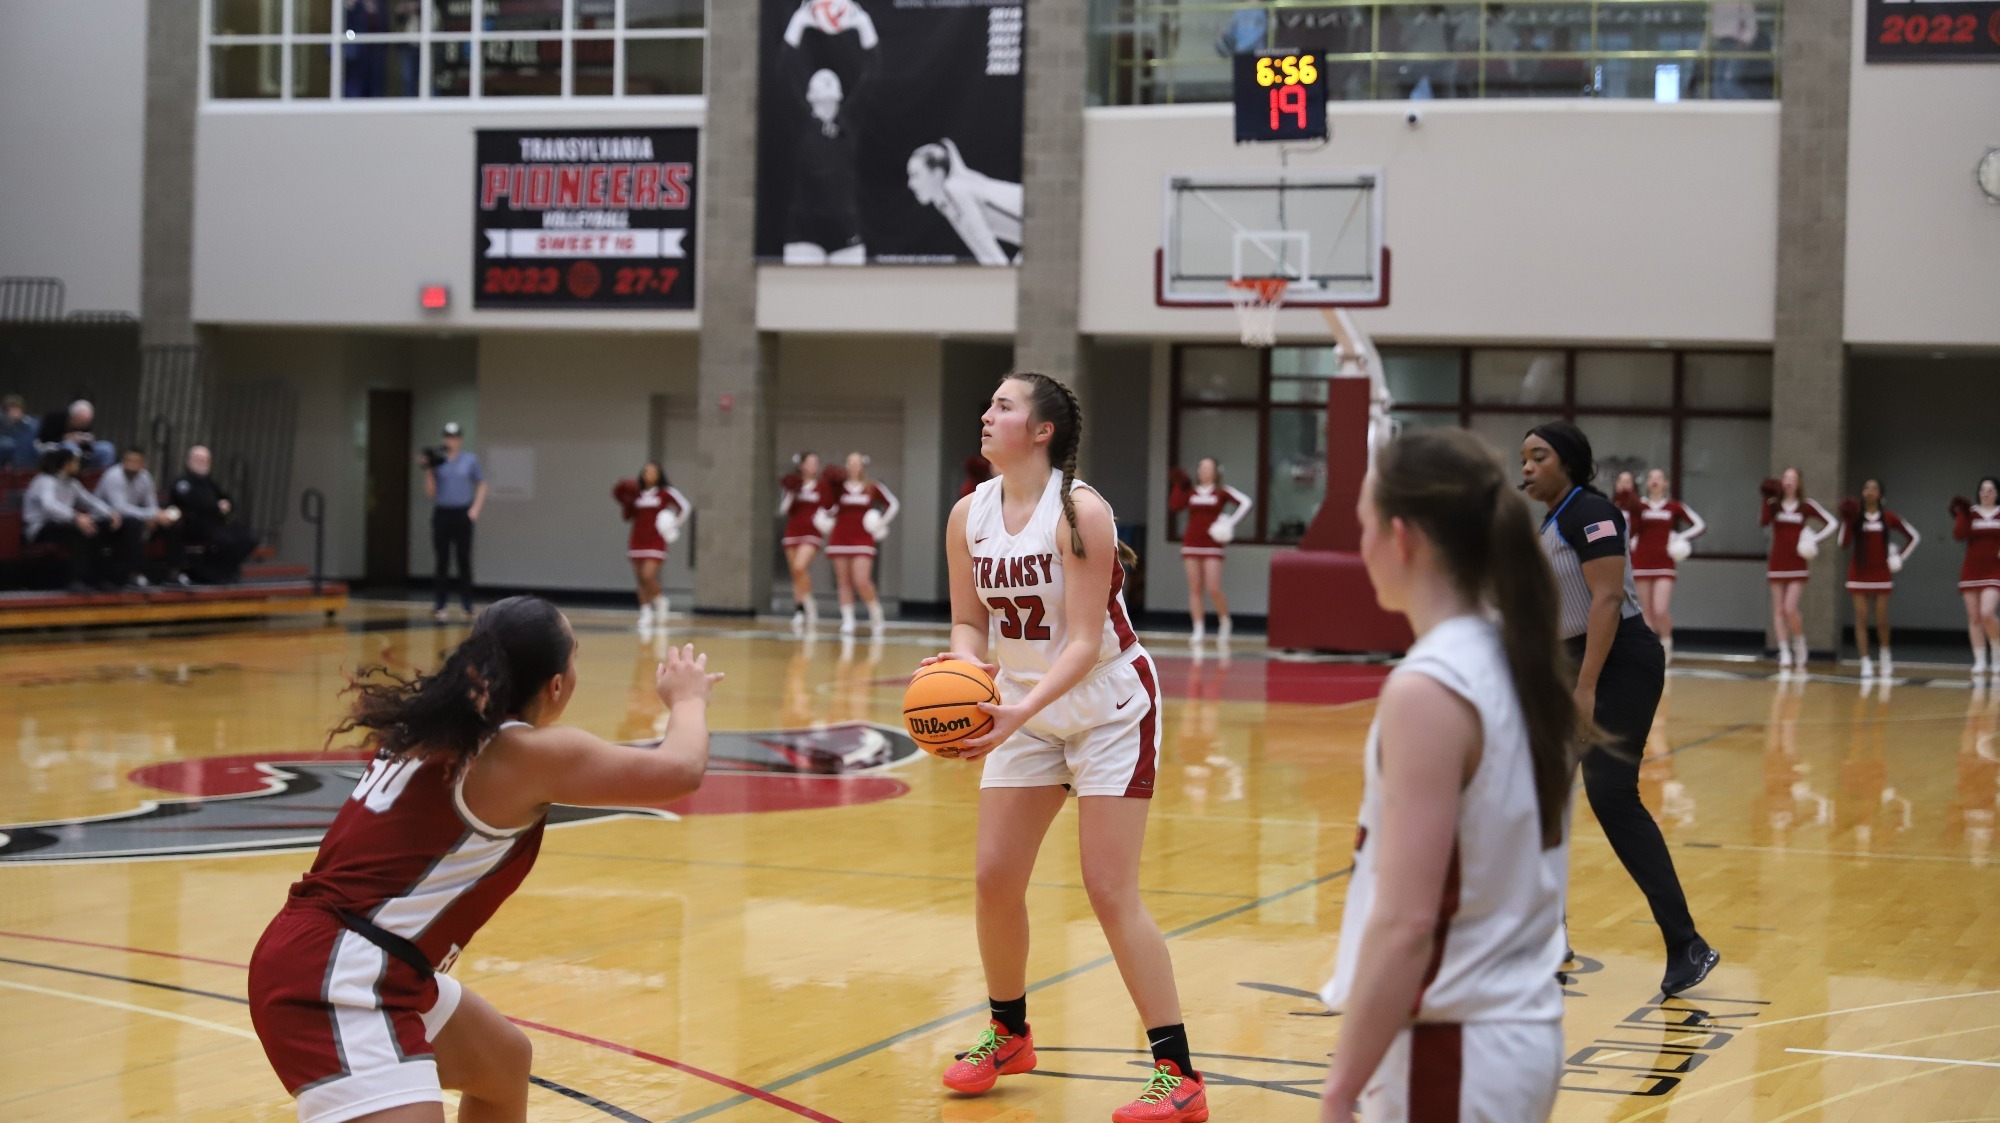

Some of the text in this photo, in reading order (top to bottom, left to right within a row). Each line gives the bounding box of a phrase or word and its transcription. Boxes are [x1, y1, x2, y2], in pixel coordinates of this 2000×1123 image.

[1879, 13, 1978, 44] 2022
[1256, 55, 1318, 87] 6:56
[1269, 84, 1307, 131] 19
[519, 136, 654, 162] TRANSYLVANIA
[481, 162, 693, 210] PIONEERS
[542, 210, 630, 230] VOLLEYBALL
[537, 235, 635, 251] SWEET 16
[483, 267, 679, 294] 2023 27-7
[973, 553, 1053, 588] TRANSY
[987, 595, 1050, 641] 32
[909, 715, 972, 735] Wilson
